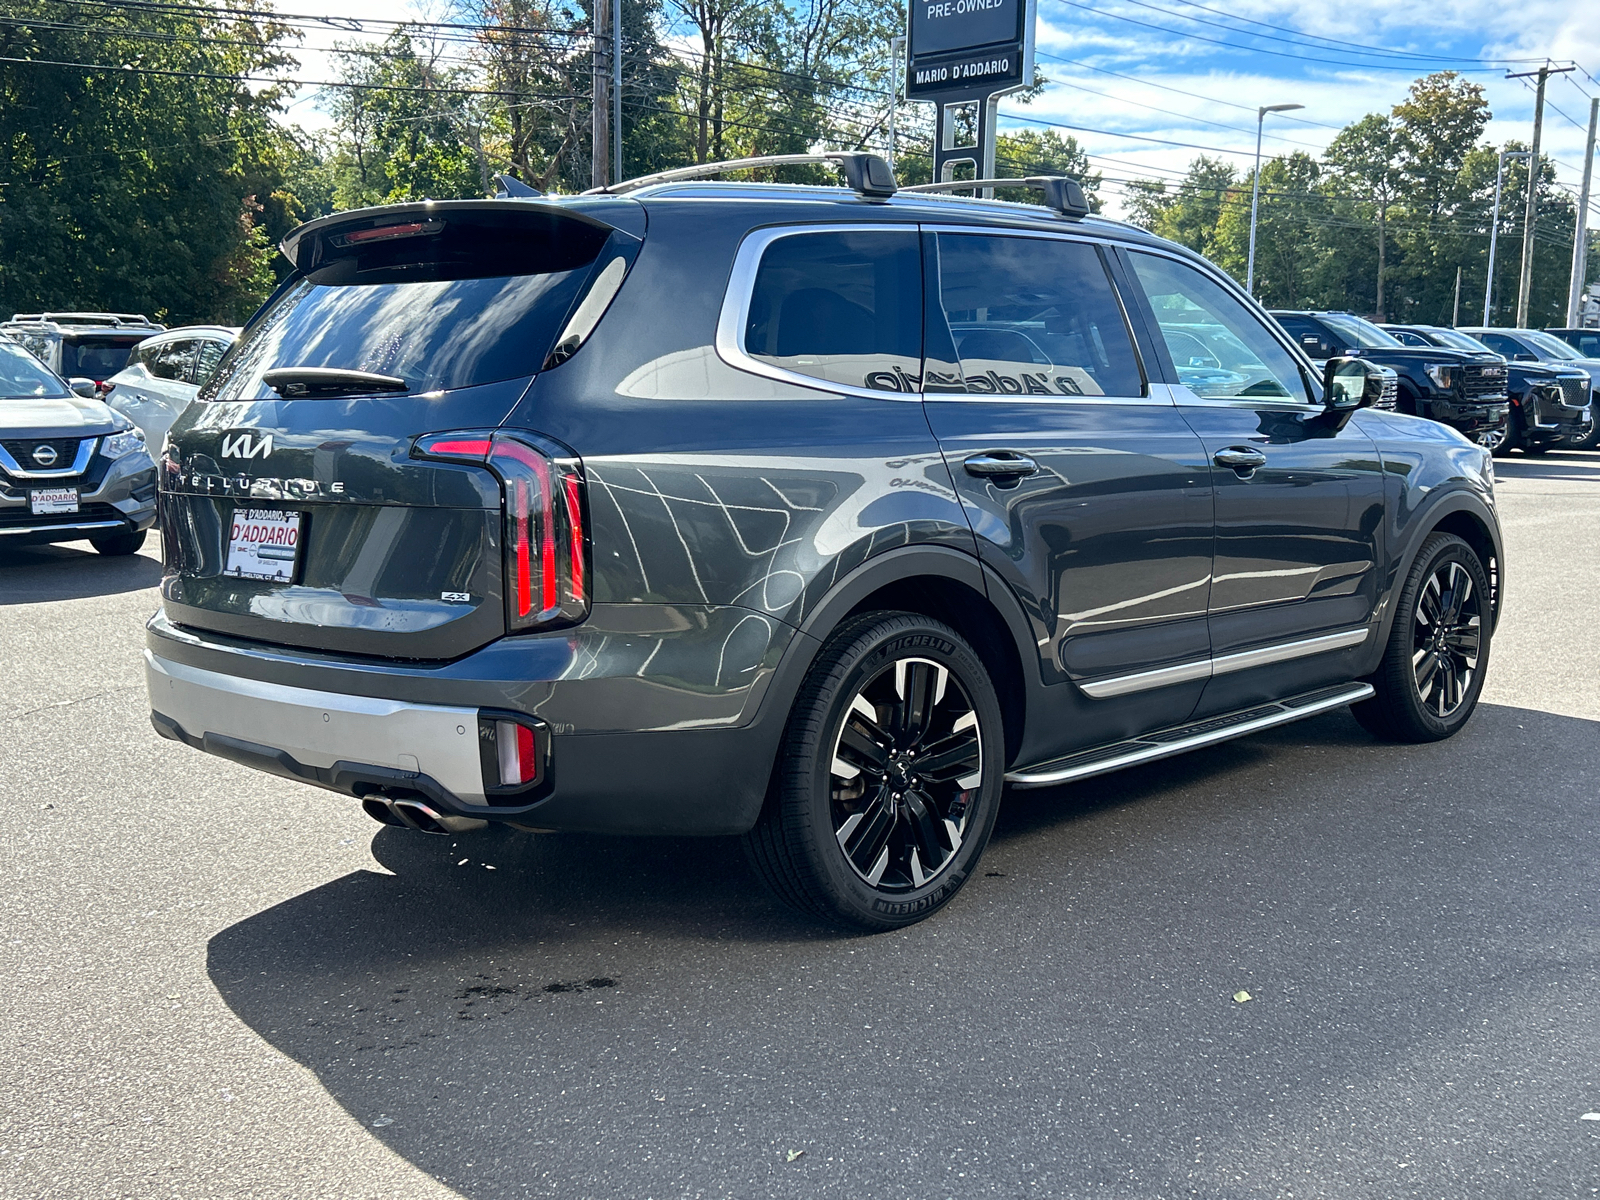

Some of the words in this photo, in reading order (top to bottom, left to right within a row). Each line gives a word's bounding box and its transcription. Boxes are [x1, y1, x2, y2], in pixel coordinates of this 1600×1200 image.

[927, 0, 1003, 19] PRE-OWNED
[916, 68, 948, 84] MARIO
[953, 58, 1009, 79] D'ADDARIO
[221, 434, 274, 460] KIA
[180, 475, 344, 493] TELLURIDE
[31, 494, 77, 502] D'ADDARIO
[249, 508, 283, 521] D'ADDARIO
[230, 523, 298, 545] D'ADDARIO
[885, 635, 953, 655] MICHELIN
[877, 889, 944, 914] MICHELIN
